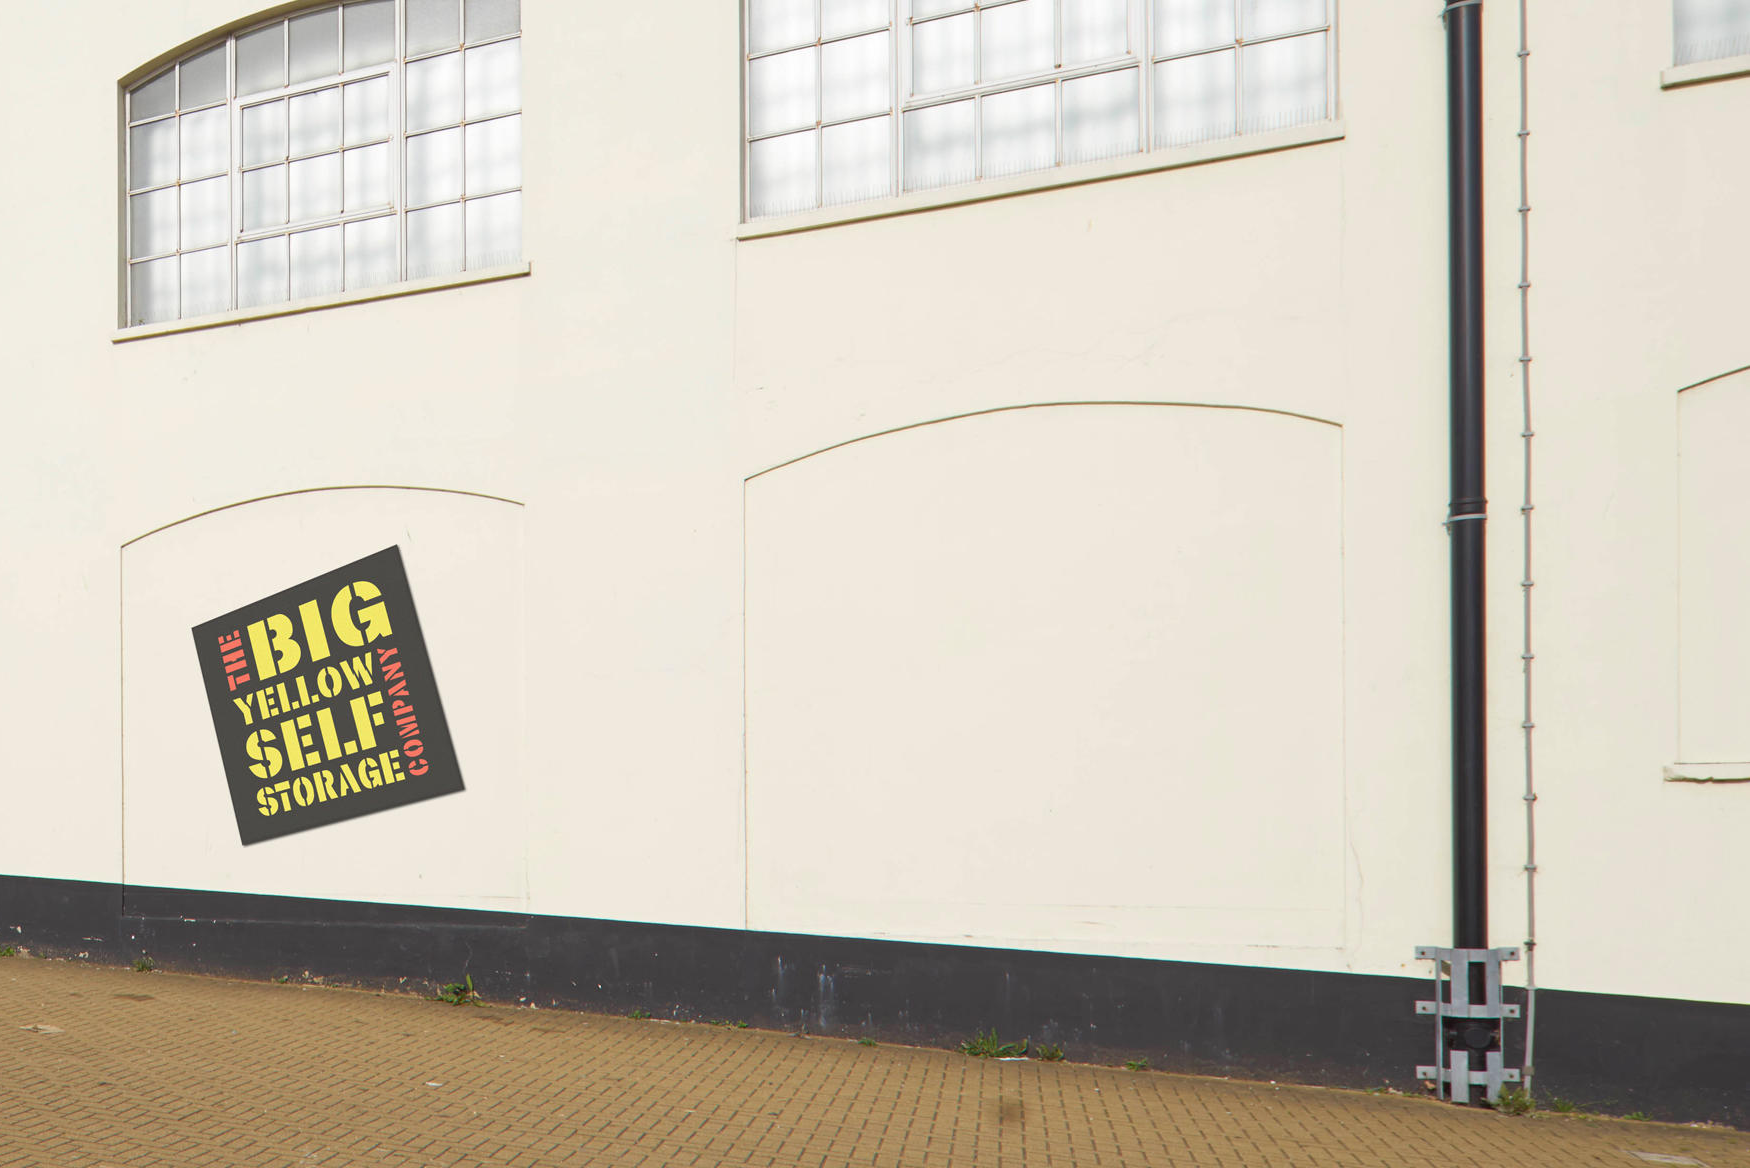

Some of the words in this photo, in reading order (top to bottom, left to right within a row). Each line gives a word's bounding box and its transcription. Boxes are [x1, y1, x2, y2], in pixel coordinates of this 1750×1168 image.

[218, 629, 251, 692] THE
[247, 580, 393, 681] BIG
[233, 651, 374, 726] YELLOW
[377, 647, 429, 776] COMPANY
[245, 690, 385, 779] SELF
[256, 749, 406, 817] STORAGE
